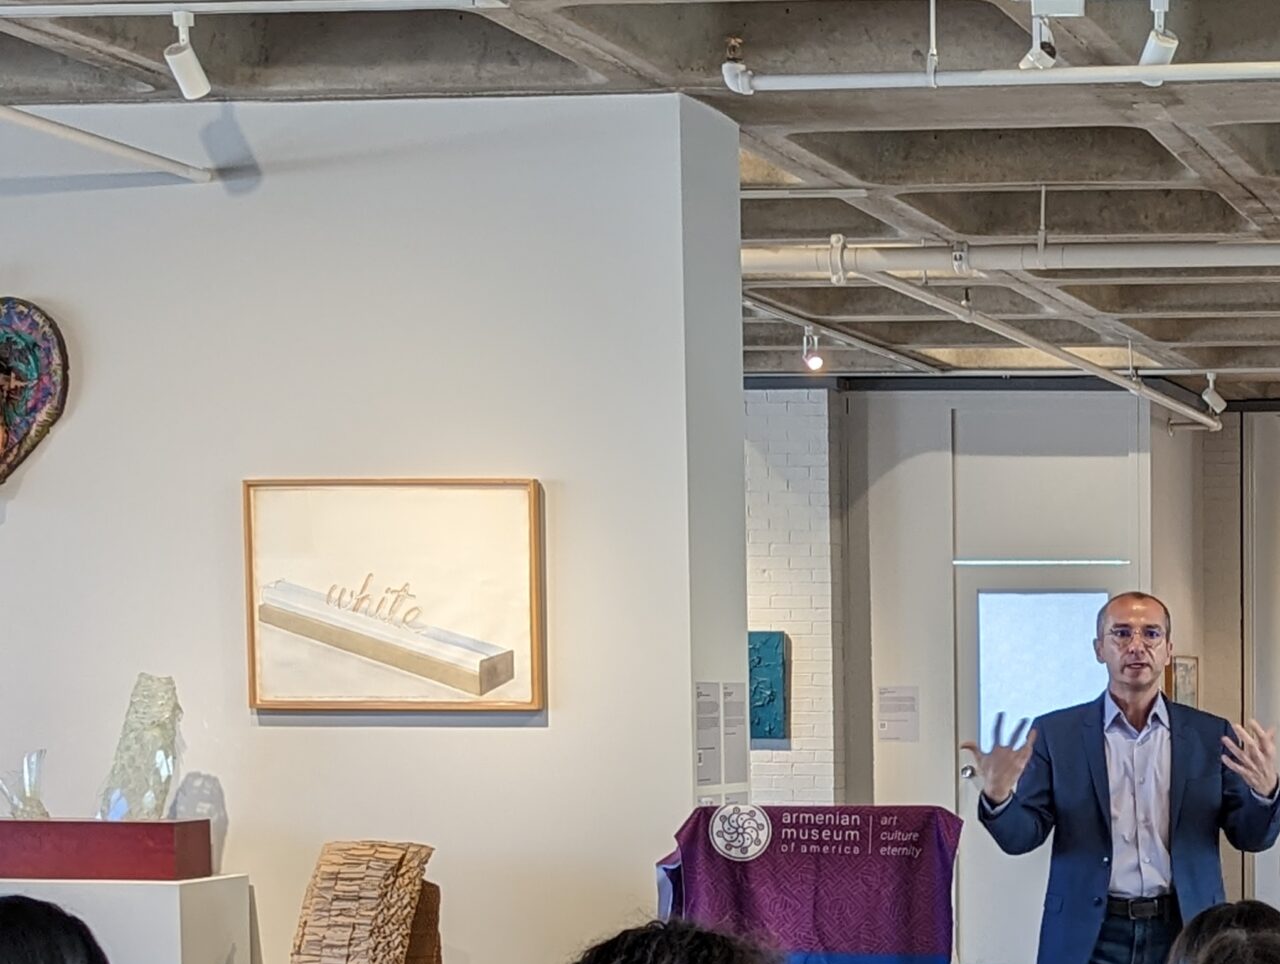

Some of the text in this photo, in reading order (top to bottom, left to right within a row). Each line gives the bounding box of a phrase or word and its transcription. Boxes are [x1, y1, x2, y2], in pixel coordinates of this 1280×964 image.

[326, 572, 428, 633] white
[782, 811, 860, 826] armenian
[880, 815, 898, 826] art
[781, 828, 860, 841] museum
[880, 830, 920, 841] culture
[781, 842, 860, 855] of america
[880, 845, 922, 859] eternity
